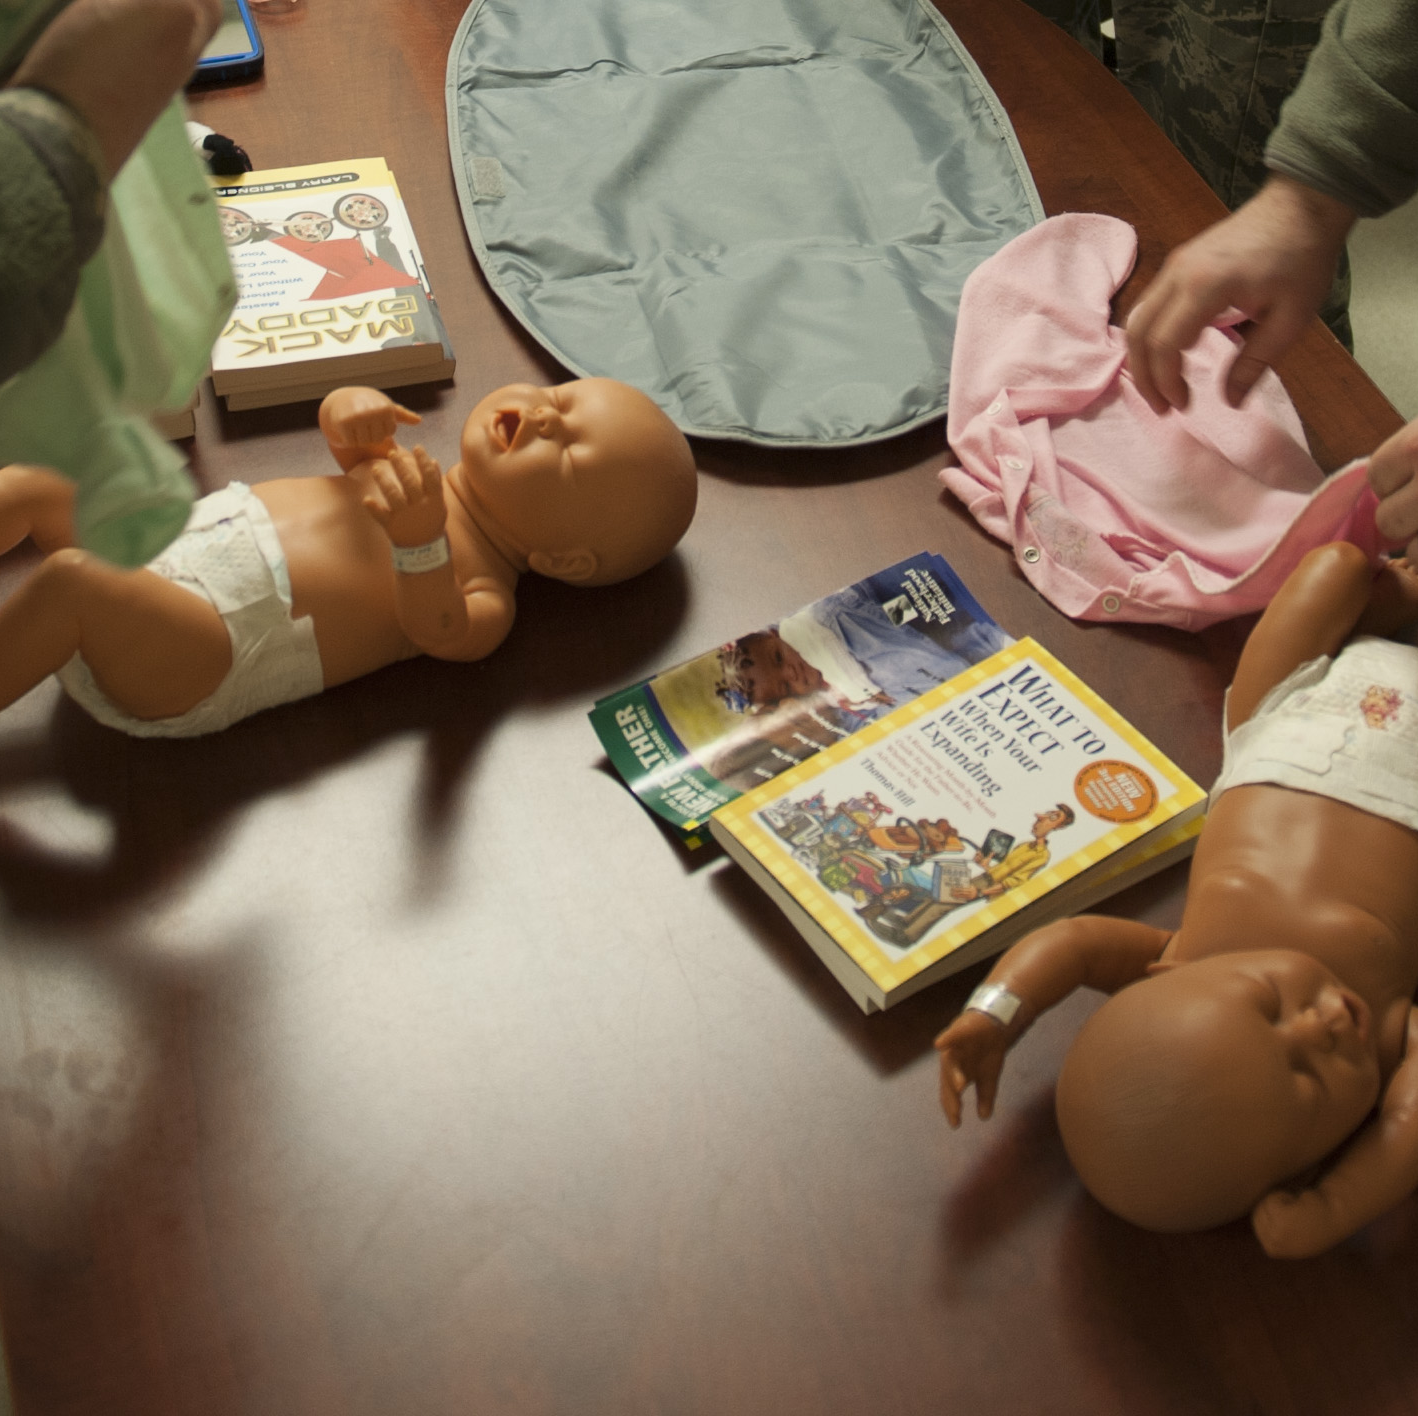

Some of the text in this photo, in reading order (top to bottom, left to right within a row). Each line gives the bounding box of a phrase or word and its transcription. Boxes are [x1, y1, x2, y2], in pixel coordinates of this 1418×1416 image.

[302, 174, 354, 188] LARRY
[221, 294, 419, 337] DADDY
[233, 315, 416, 359] MACK
[901, 580, 932, 623] National
[904, 568, 951, 625] Fatherhood
[919, 569, 956, 615] Initiative
[977, 681, 1065, 756] EXPECT
[1008, 665, 1106, 755] WHAT TO
[939, 710, 993, 758] Wife Is
[959, 699, 1043, 773] When Your
[860, 758, 916, 807] Thomas Hill
[920, 721, 1003, 798] Expanding
[669, 785, 719, 814] NEW
[1108, 780, 1136, 812] EDITION
[1114, 771, 1142, 800] NEW
